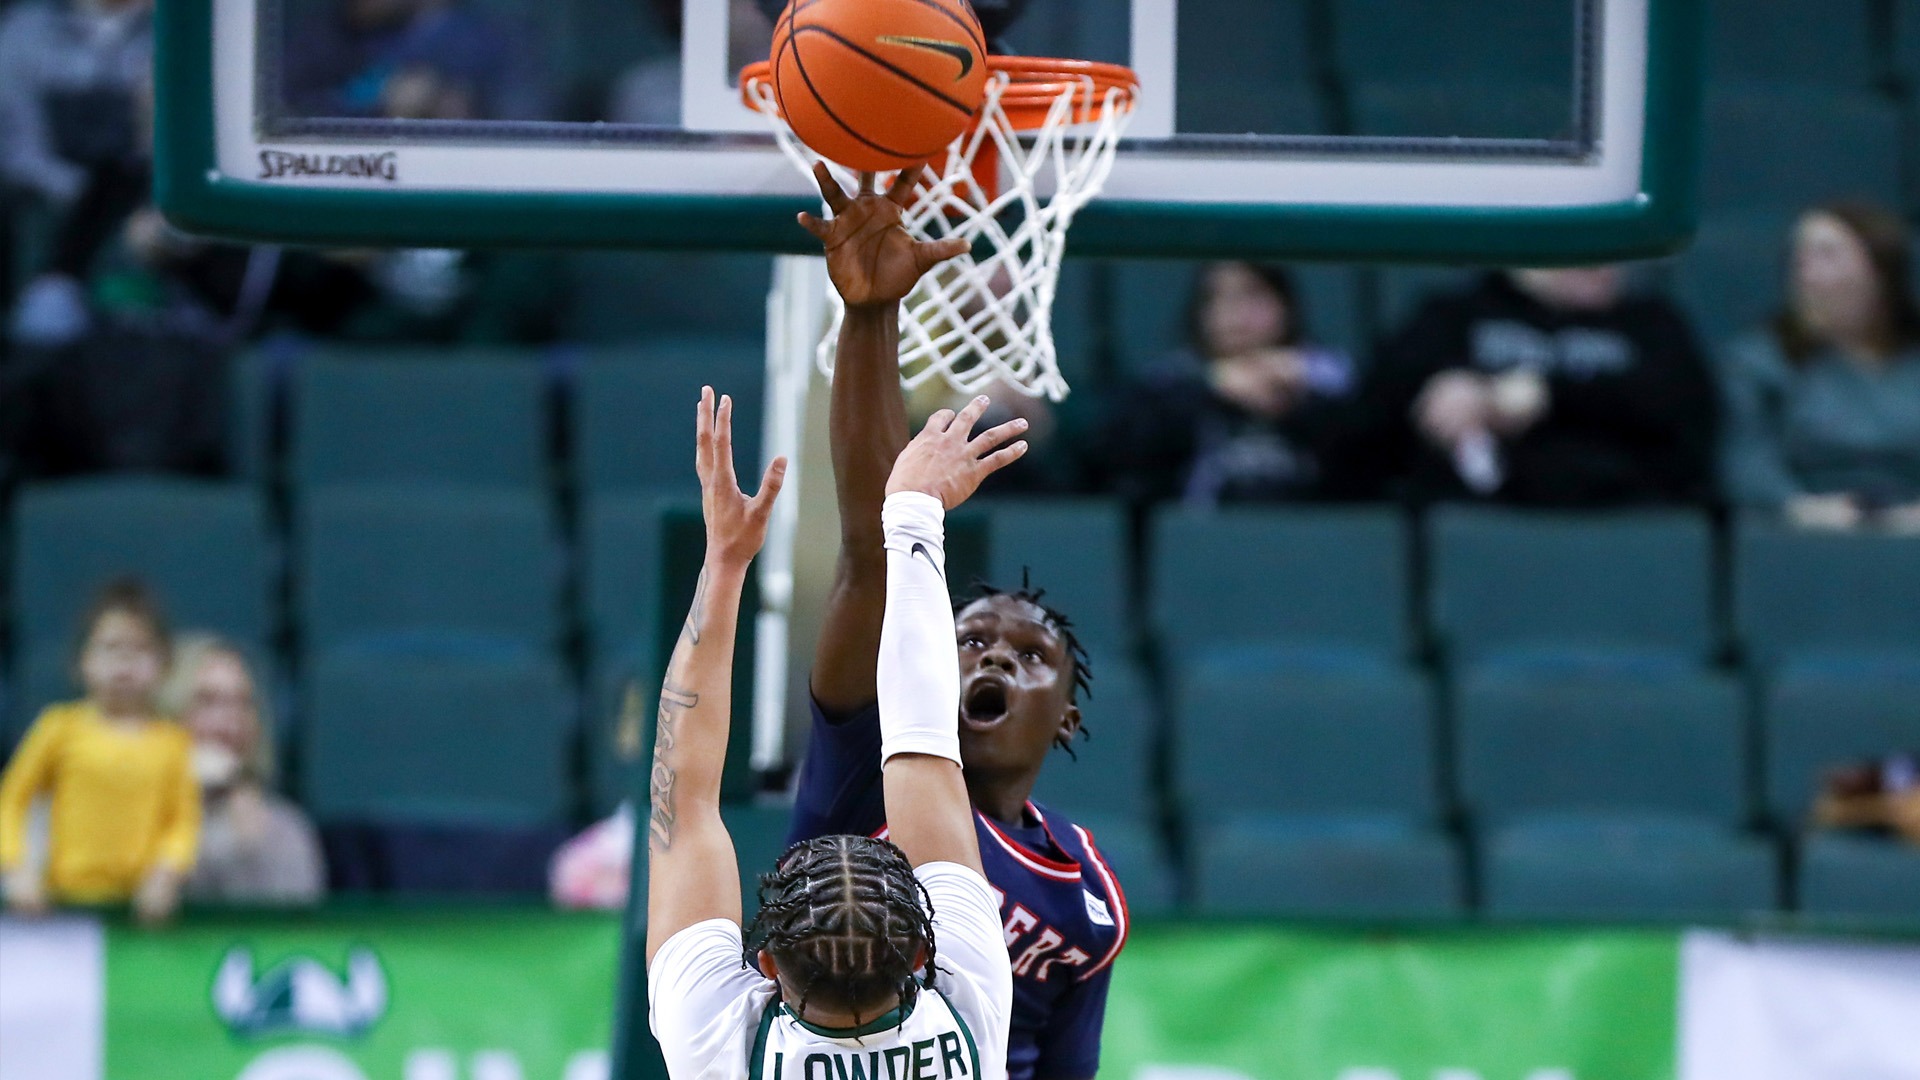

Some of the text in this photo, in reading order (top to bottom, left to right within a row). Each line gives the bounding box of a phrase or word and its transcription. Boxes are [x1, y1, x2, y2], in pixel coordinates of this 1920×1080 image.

[259, 150, 397, 181] SPALDING
[991, 884, 1092, 982] ERT
[774, 1031, 968, 1080] LOWDER
